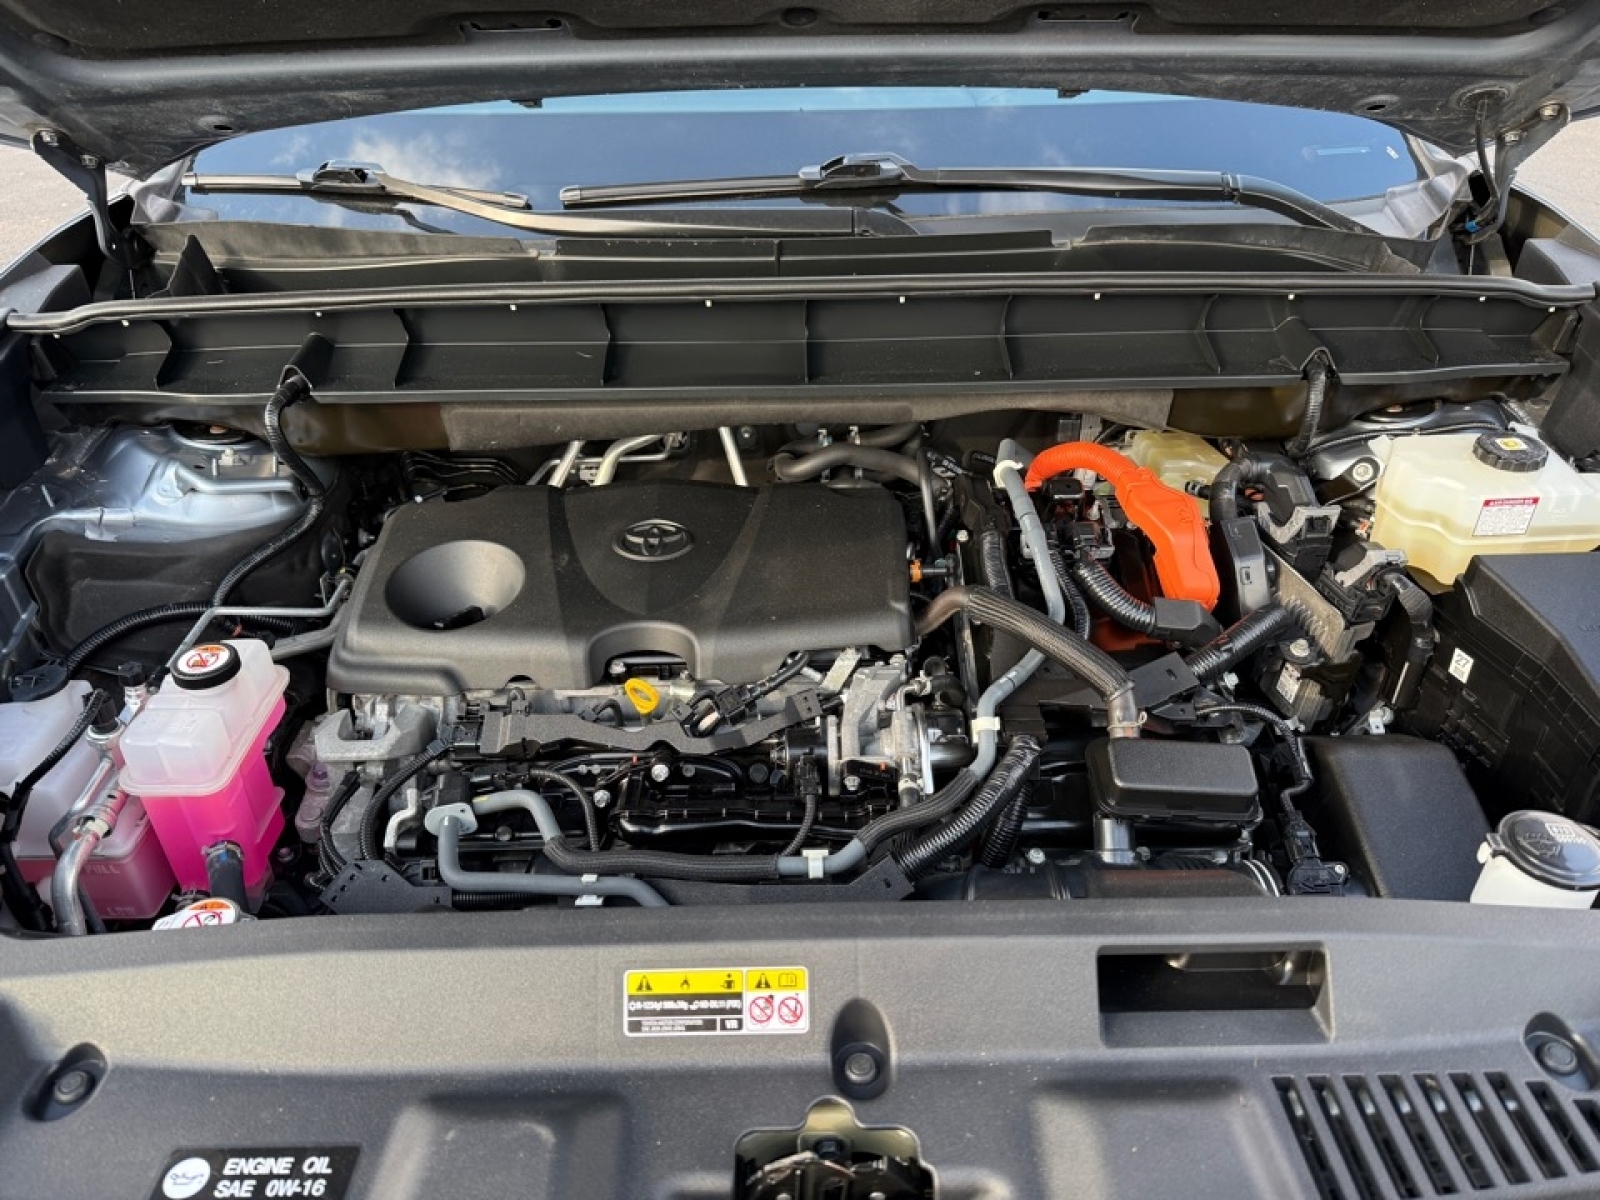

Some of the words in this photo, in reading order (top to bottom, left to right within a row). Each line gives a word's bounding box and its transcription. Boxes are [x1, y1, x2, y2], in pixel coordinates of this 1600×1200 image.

[223, 1157, 294, 1175] ENGINE
[303, 1157, 332, 1174] OIL
[214, 1180, 257, 1198] SAE
[265, 1178, 327, 1197] 0W-16
